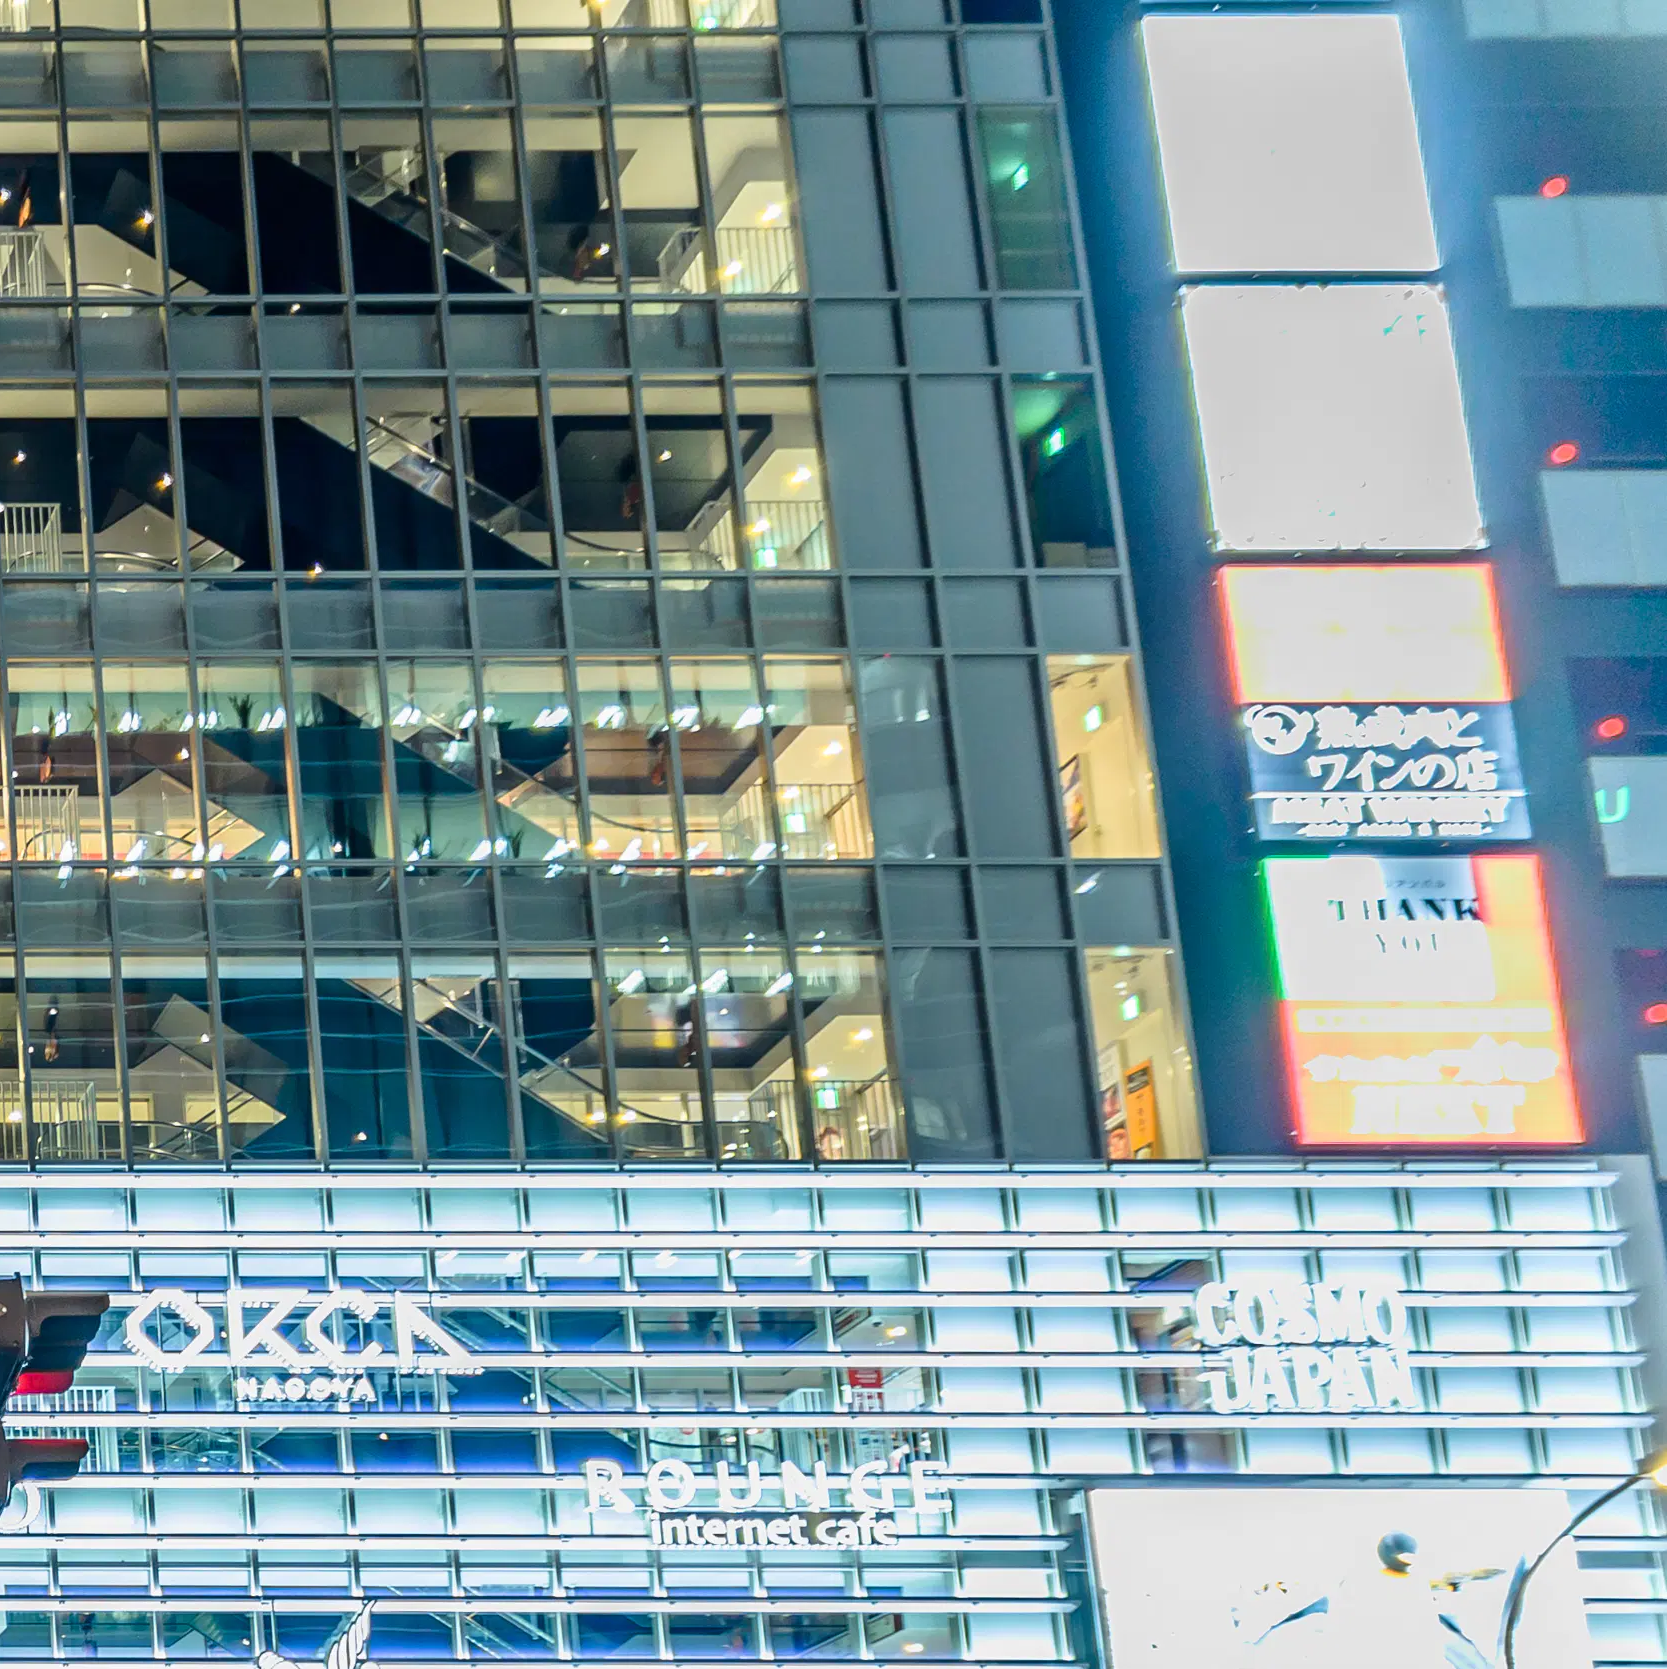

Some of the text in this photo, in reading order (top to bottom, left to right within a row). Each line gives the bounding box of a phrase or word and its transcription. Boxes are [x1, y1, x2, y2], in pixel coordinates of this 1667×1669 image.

[1307, 750, 1500, 792] ワインの店
[1196, 1280, 1408, 1346] COSMO
[236, 1376, 377, 1402] NAGOYA
[1196, 1346, 1419, 1414] JAPAN
[583, 1458, 953, 1513] ROUNGE
[651, 1510, 899, 1546] internet cafe
